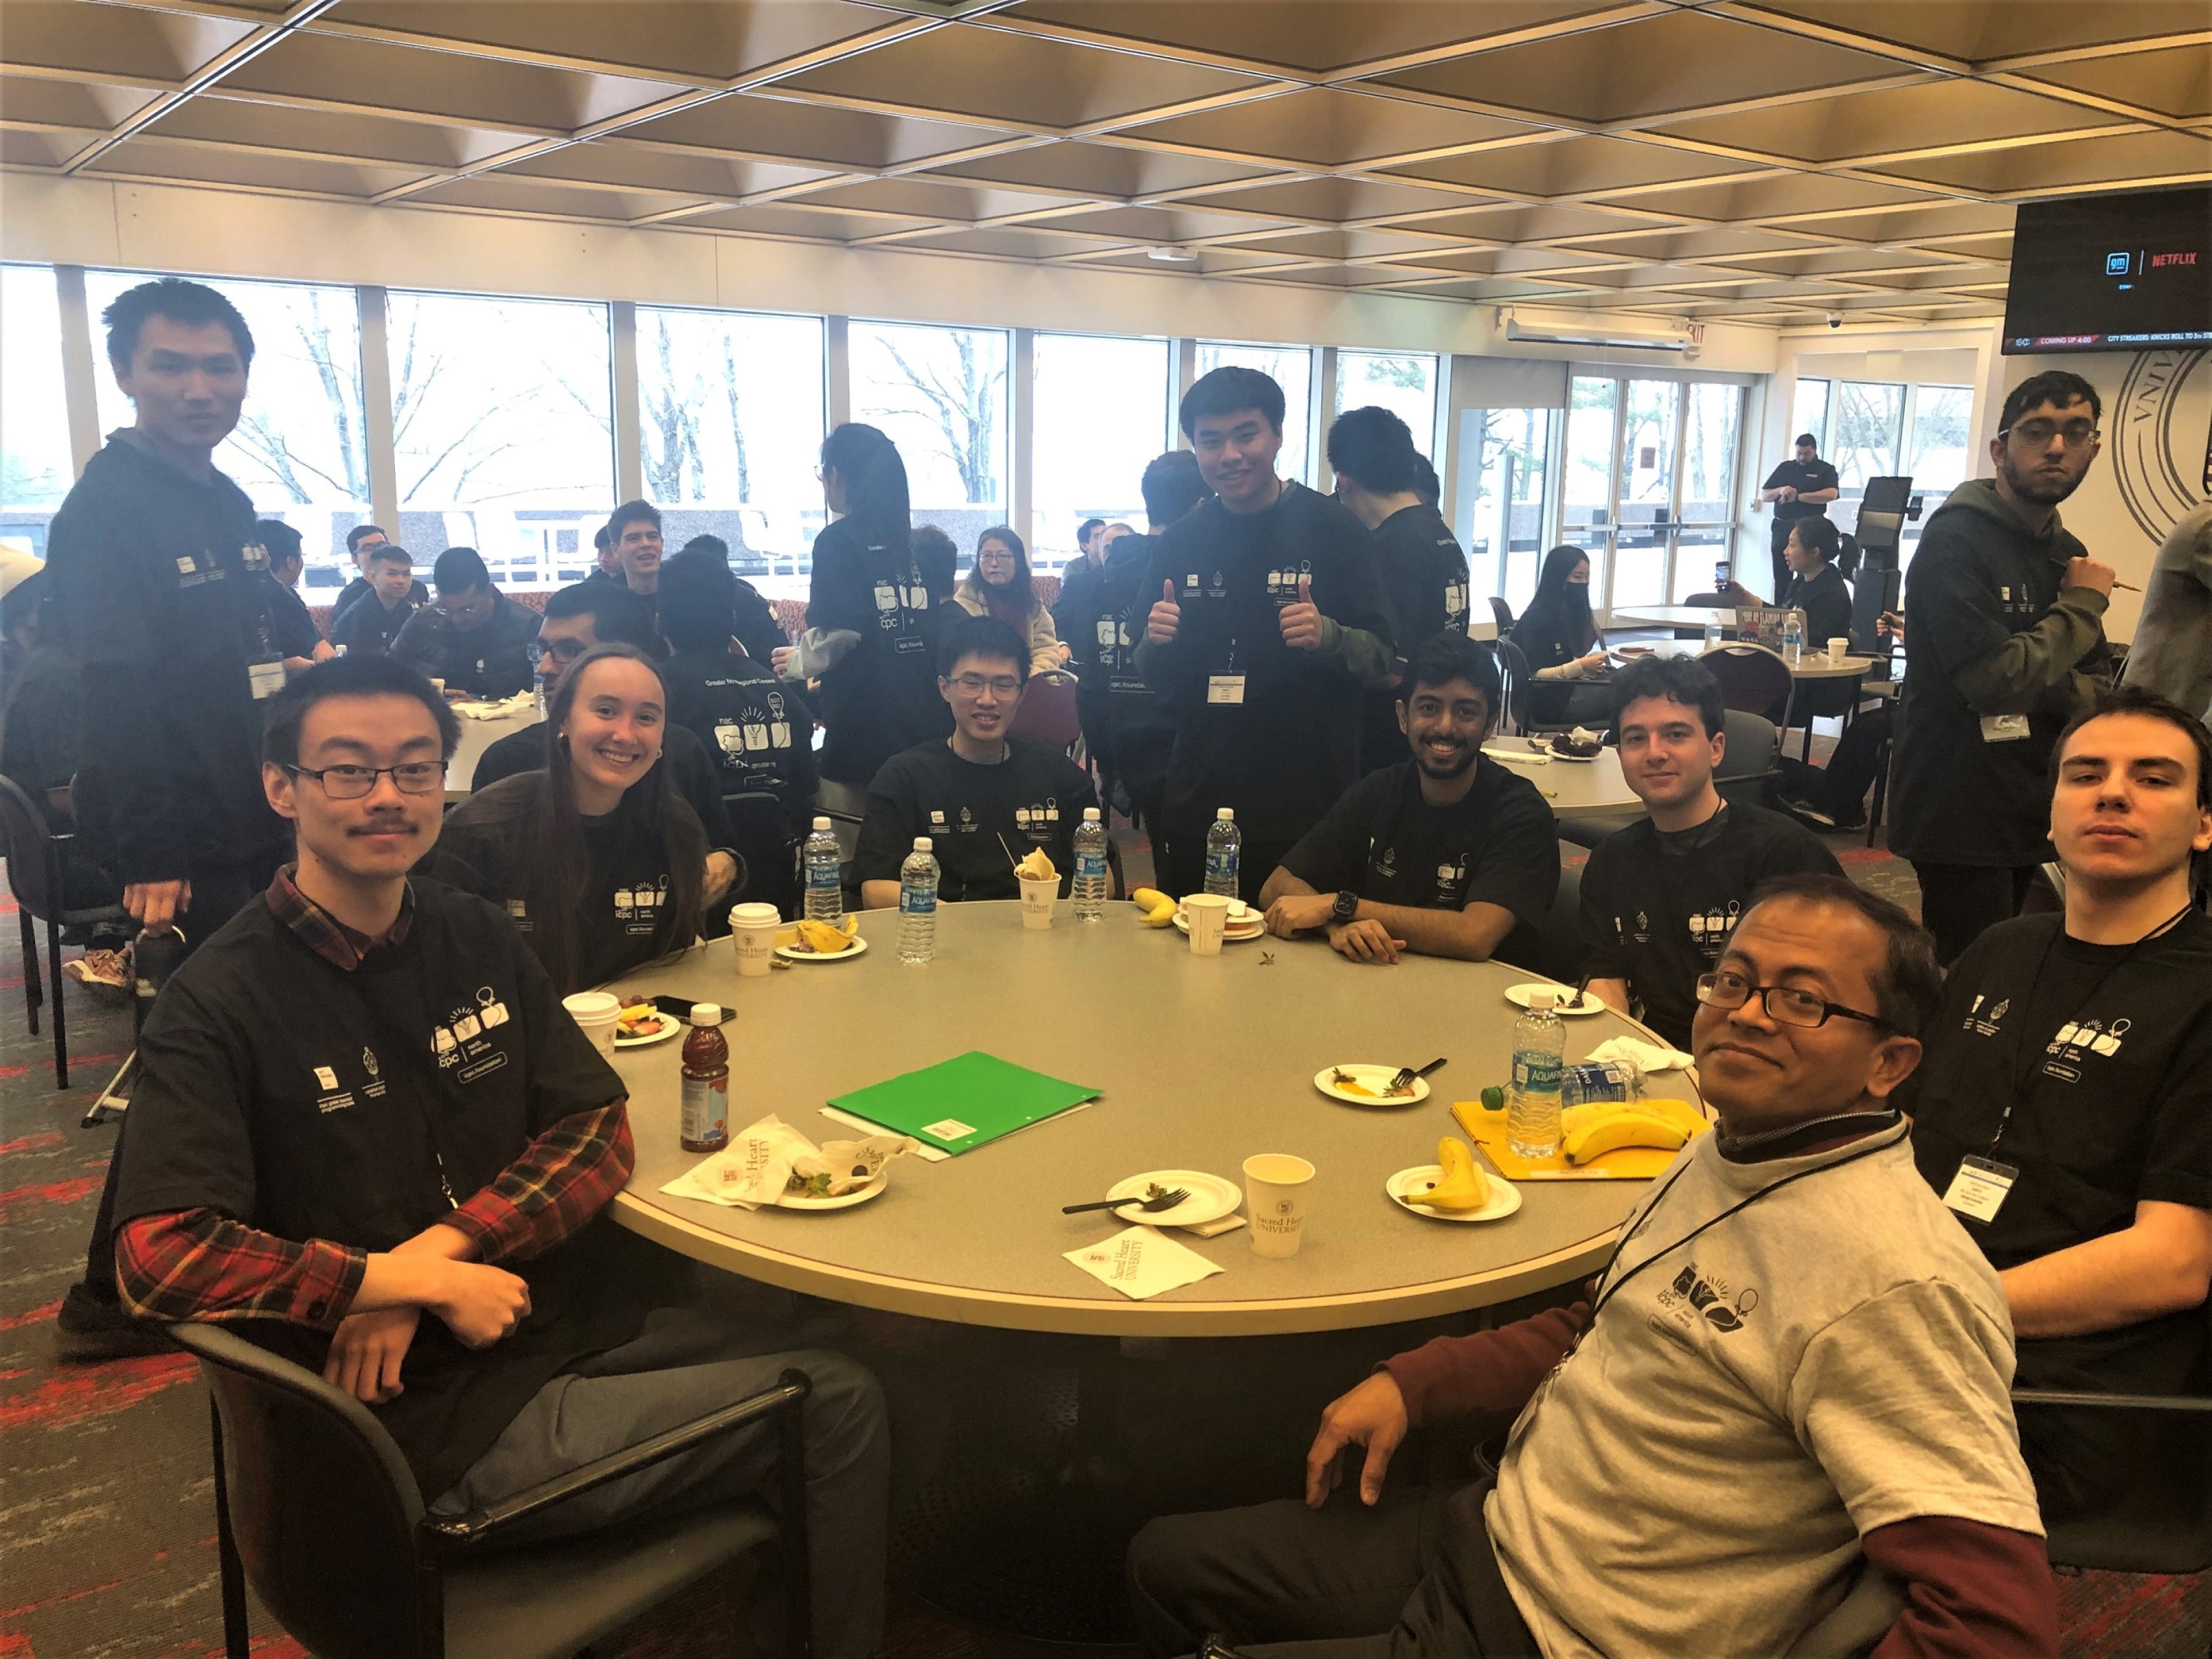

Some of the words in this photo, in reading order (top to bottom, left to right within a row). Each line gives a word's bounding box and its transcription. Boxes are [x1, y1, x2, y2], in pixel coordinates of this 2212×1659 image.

[2111, 257, 2125, 269] gm
[2152, 252, 2197, 267] NETFLIX
[746, 1139, 757, 1171] Heart
[1255, 1213, 1283, 1226] Sacred
[1115, 1240, 1130, 1259] Heart
[1124, 1240, 1142, 1280] UNIVERSITY
[1110, 1260, 1126, 1280] Sacred
